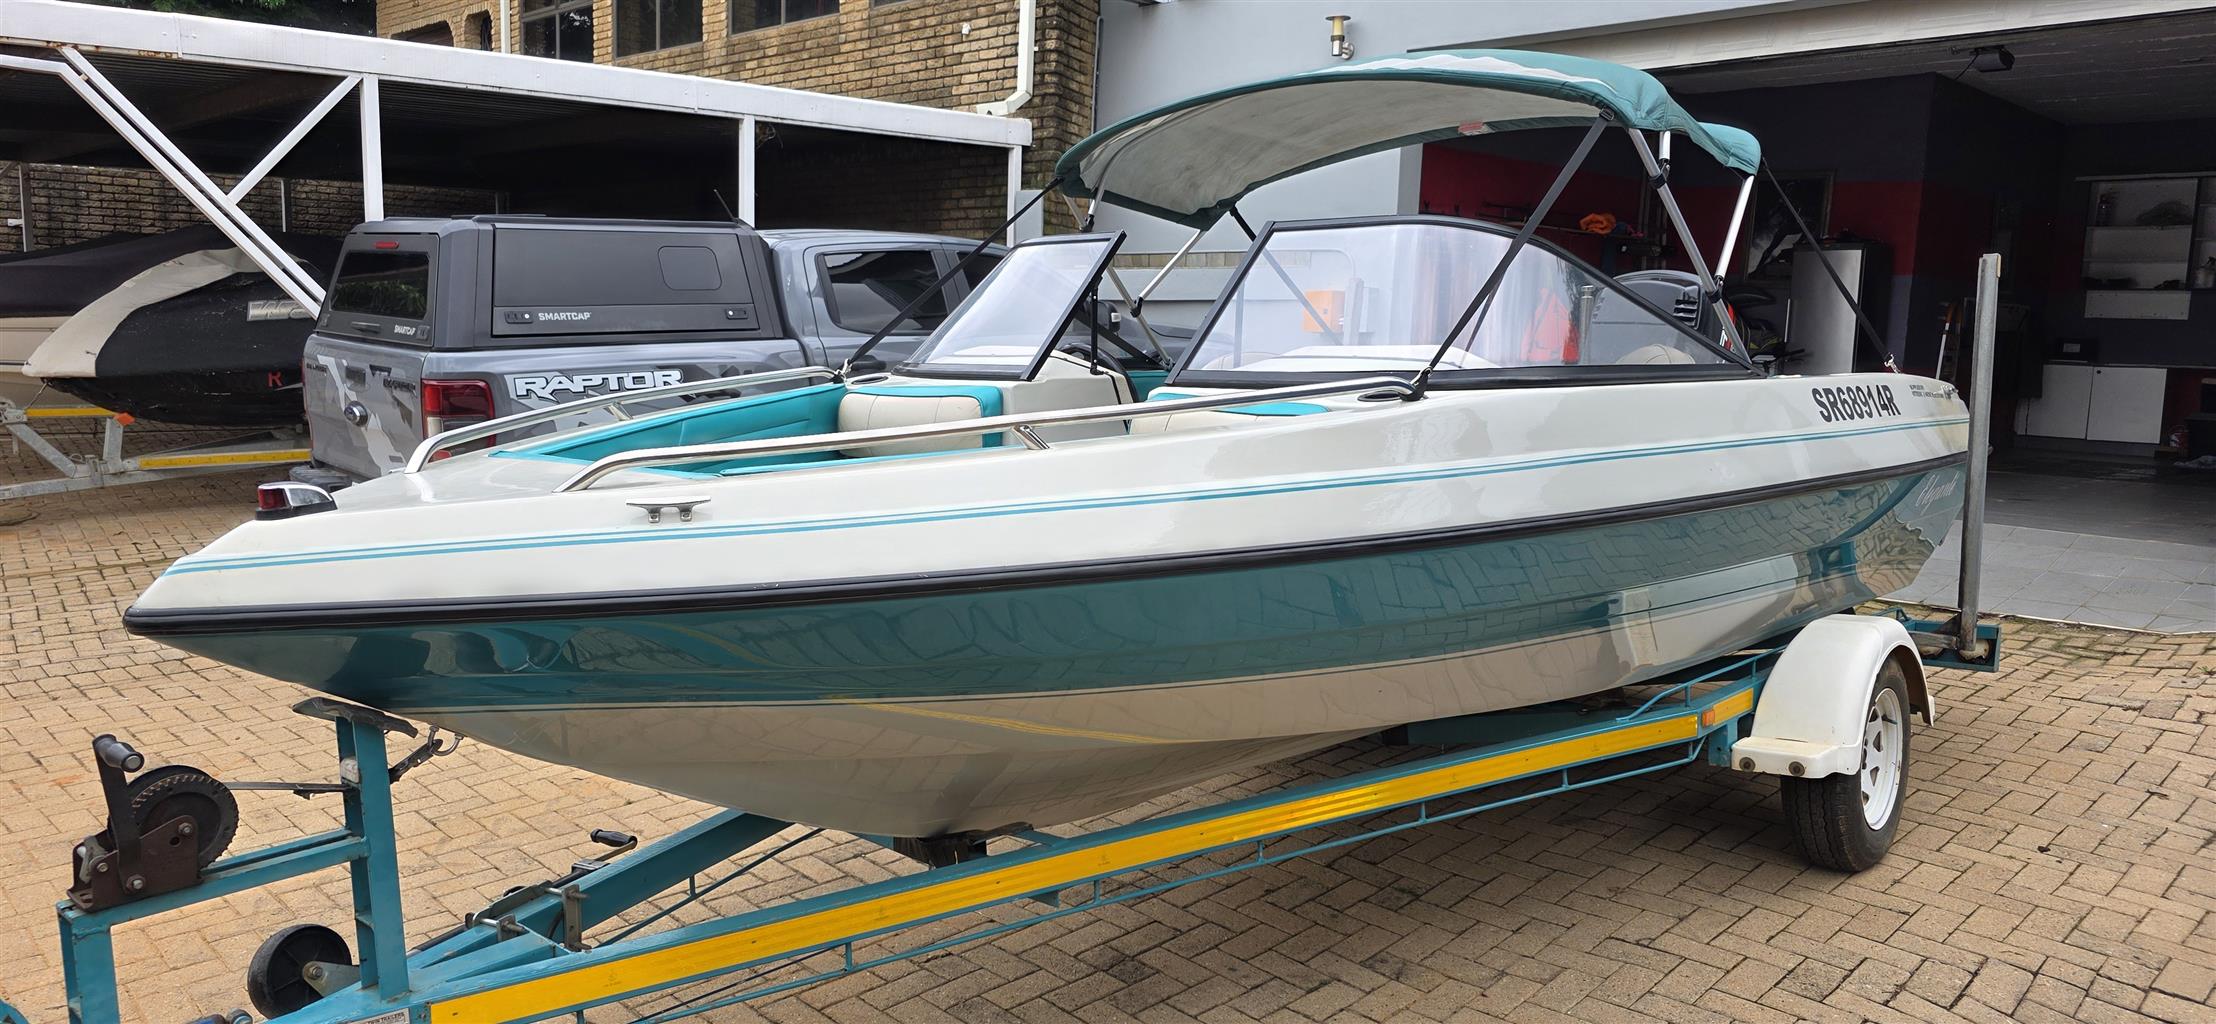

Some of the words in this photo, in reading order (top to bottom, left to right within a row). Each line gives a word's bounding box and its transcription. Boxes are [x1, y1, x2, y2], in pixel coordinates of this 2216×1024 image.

[538, 312, 592, 321] SMARTCAP
[514, 370, 683, 402] RAPTOR
[1811, 384, 1901, 422] SR68914R
